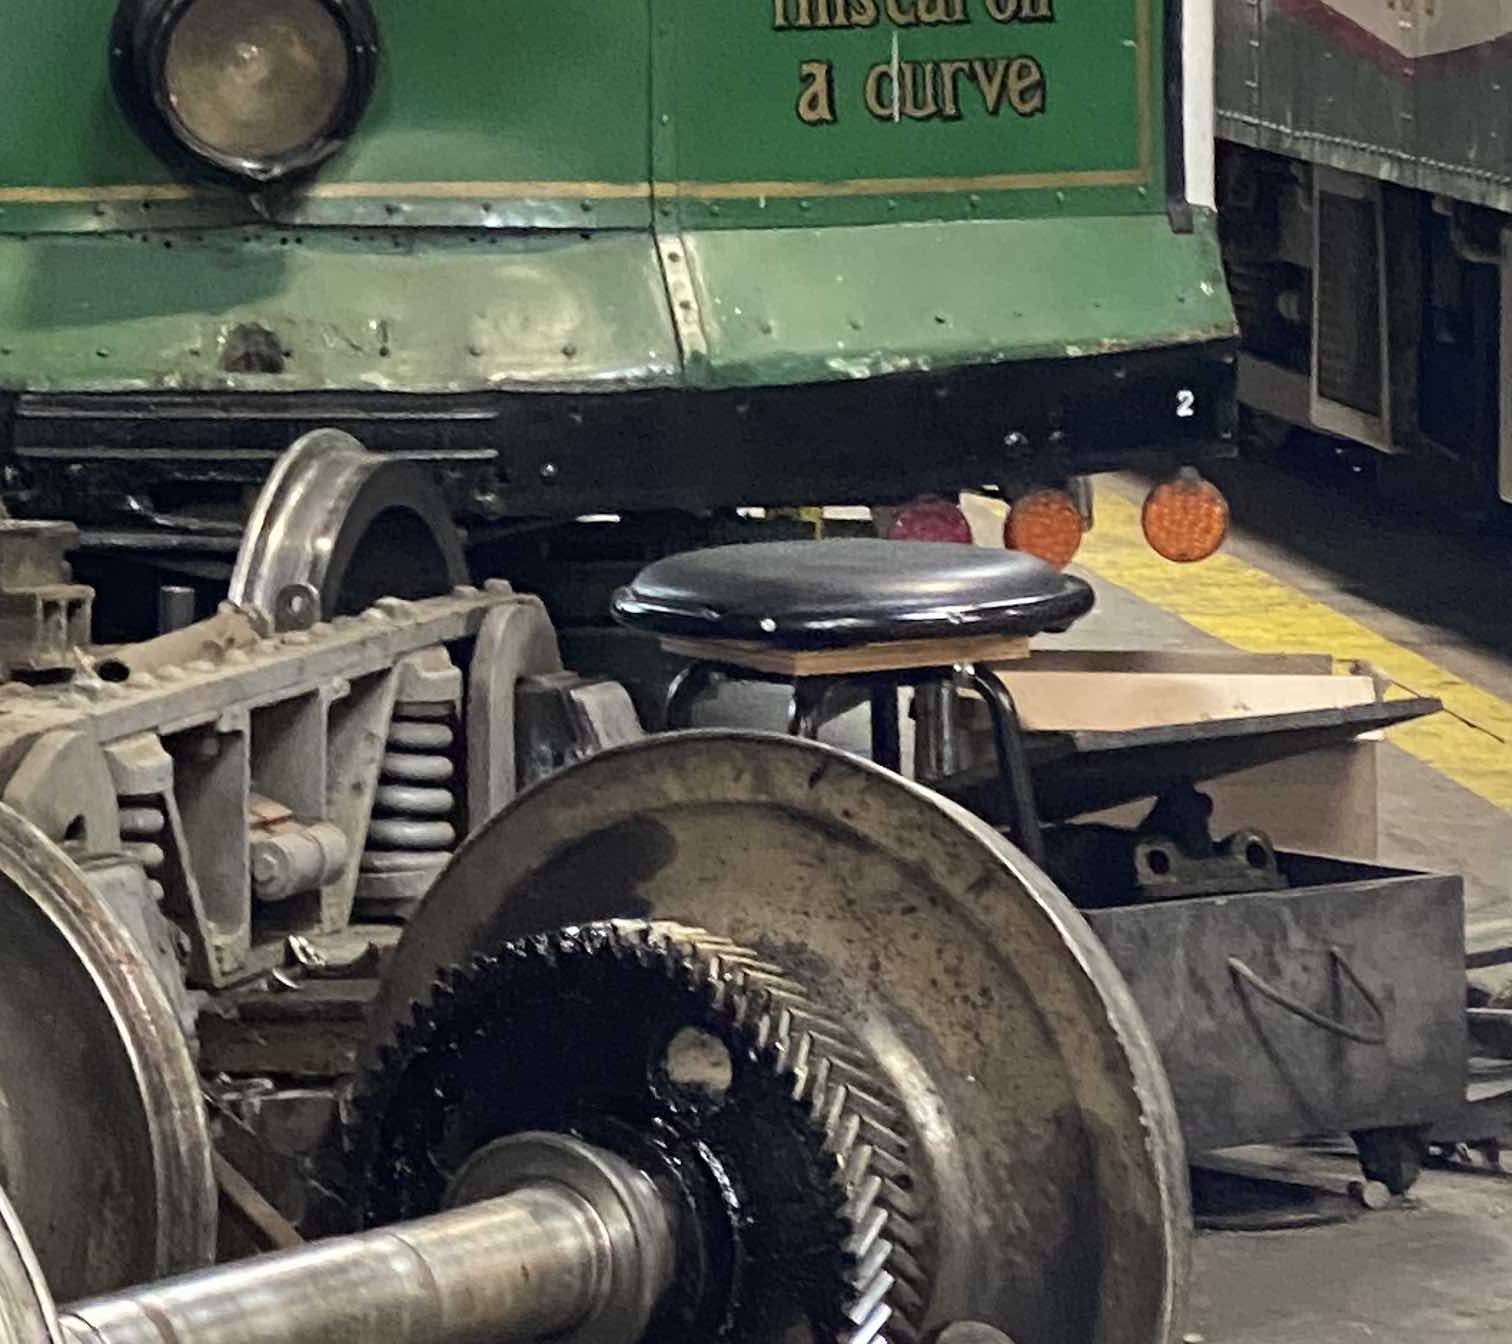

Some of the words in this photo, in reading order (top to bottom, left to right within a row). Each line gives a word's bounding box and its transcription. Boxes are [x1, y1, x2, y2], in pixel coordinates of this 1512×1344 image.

[798, 60, 836, 124] a
[865, 56, 1045, 120] curve
[1175, 390, 1195, 417] 2
